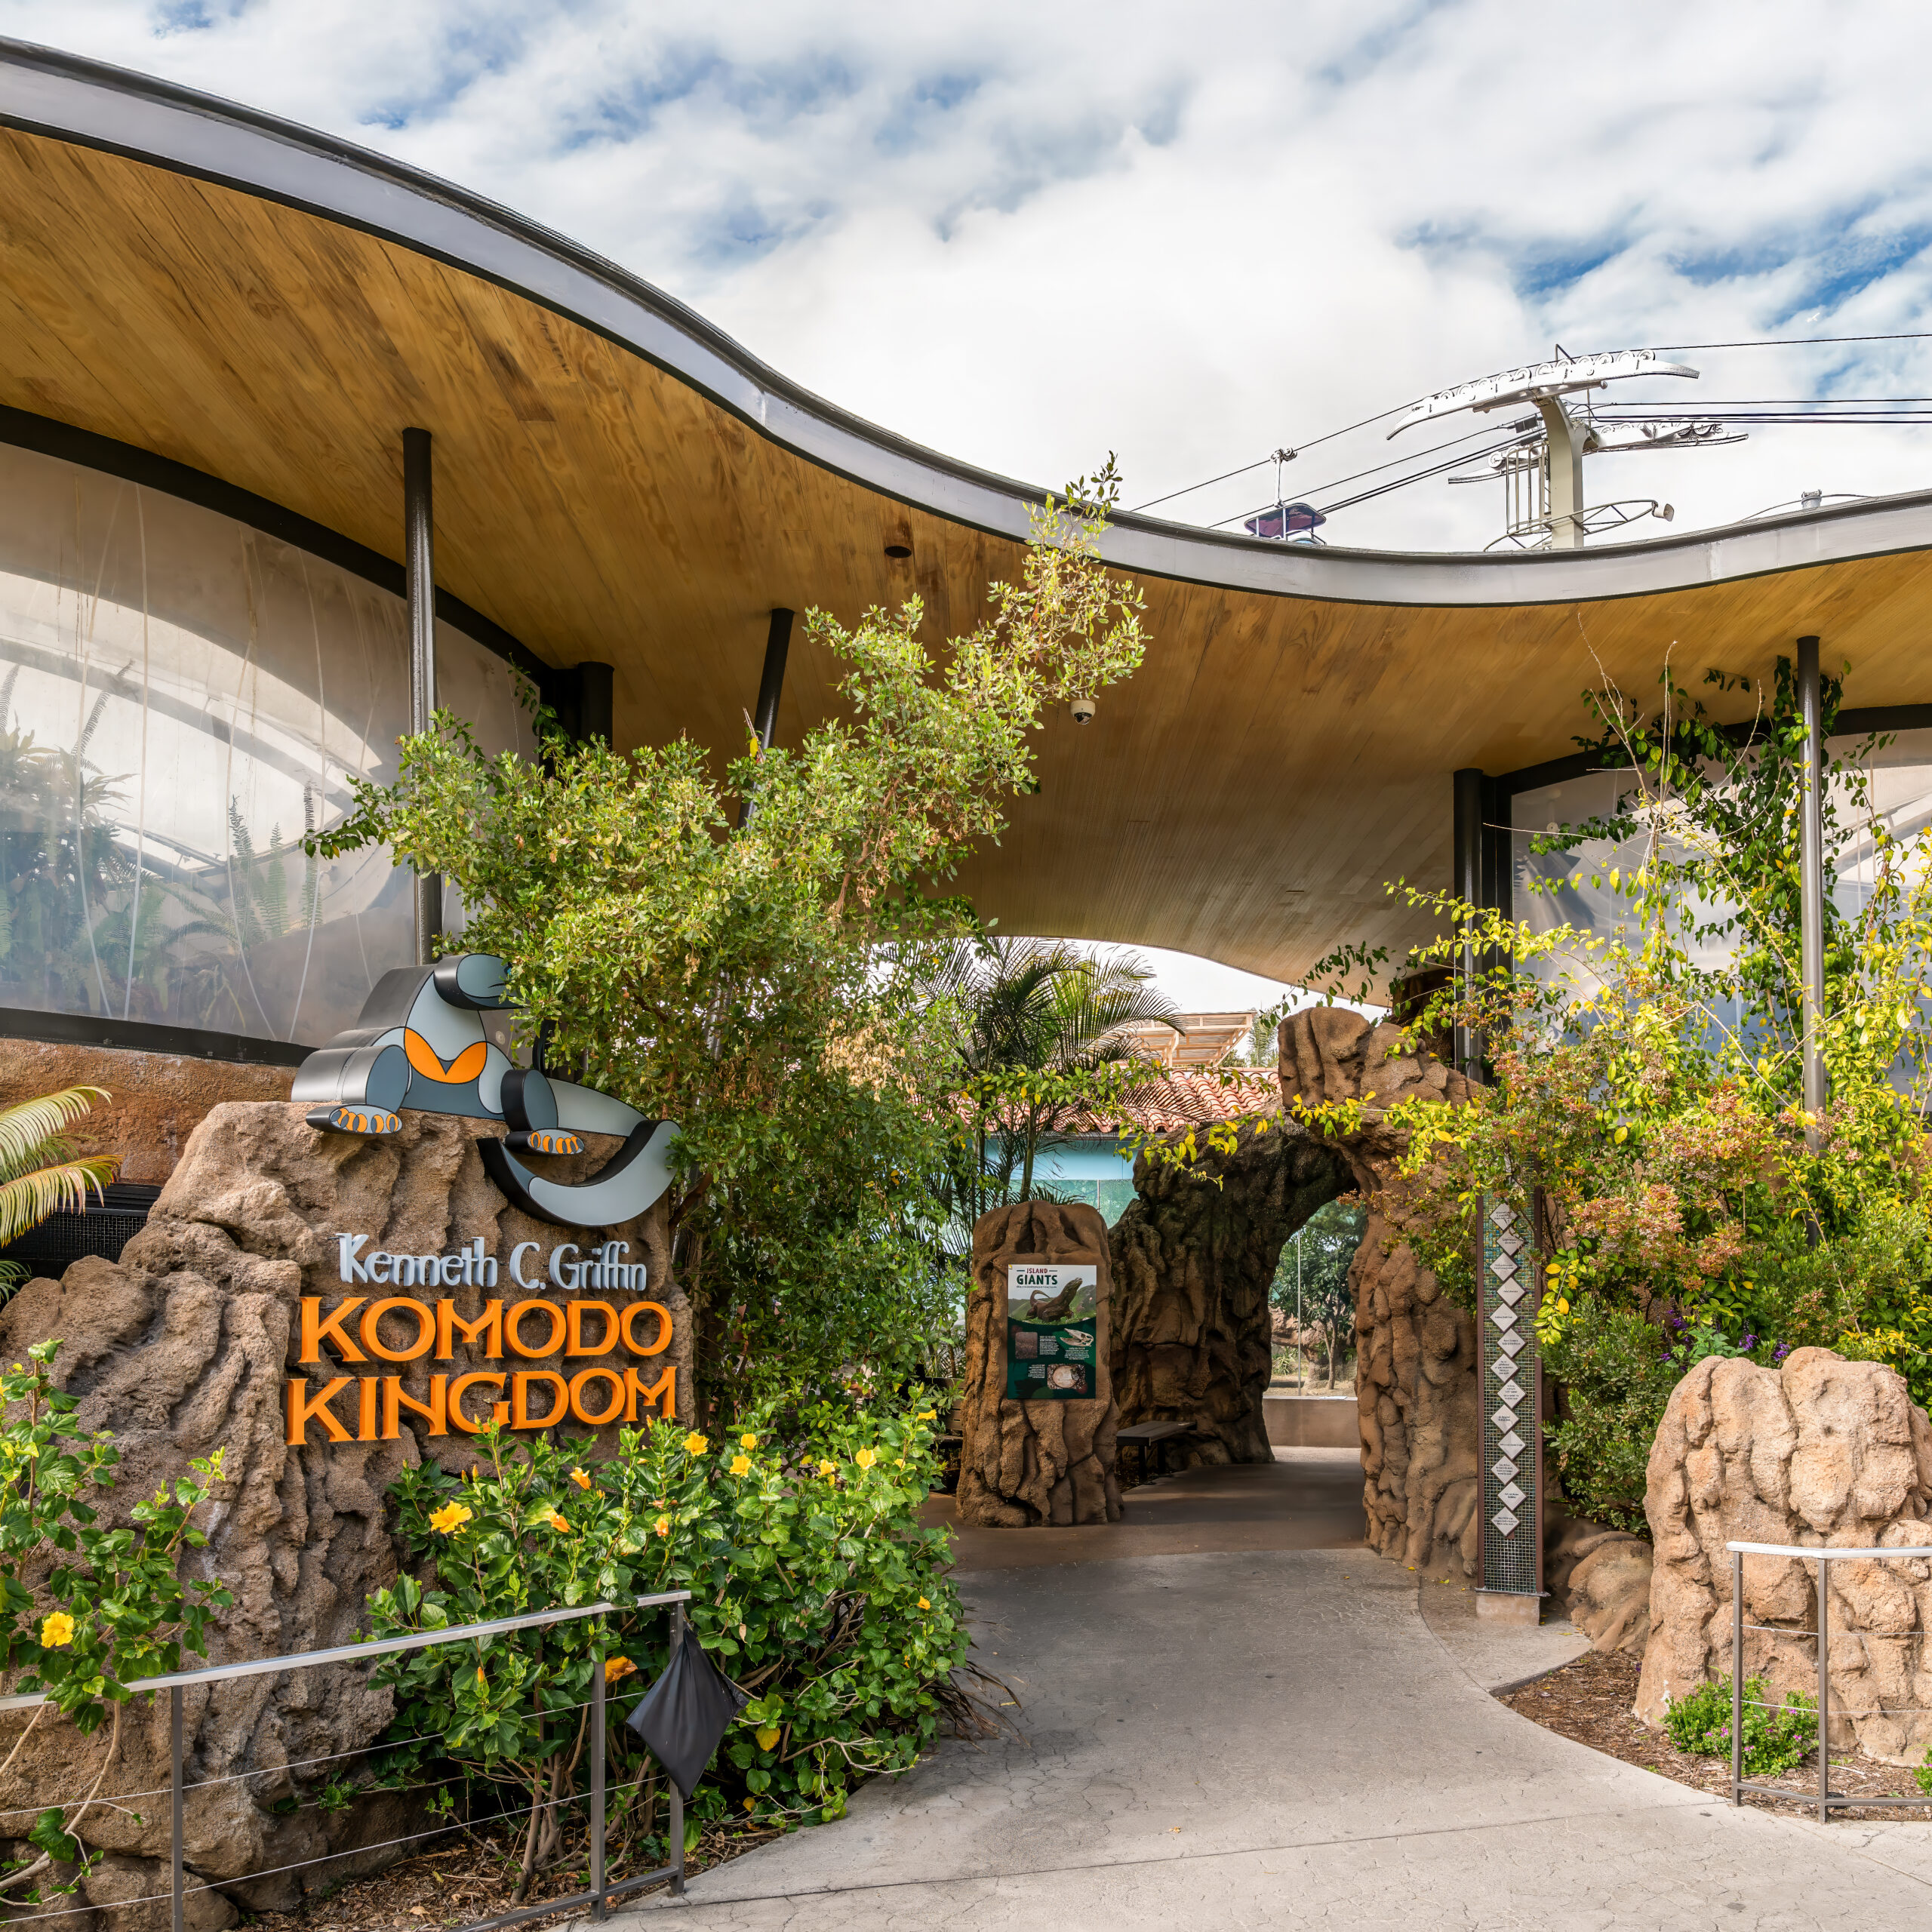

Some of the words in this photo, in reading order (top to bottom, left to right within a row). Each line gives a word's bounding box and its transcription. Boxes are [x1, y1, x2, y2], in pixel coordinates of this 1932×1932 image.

[336, 1232, 498, 1287] Kenneth
[509, 1241, 546, 1290] C.
[549, 1241, 647, 1291] Griffin
[1016, 1274, 1058, 1285] GIANTS
[298, 1297, 673, 1363] KOMODO
[285, 1366, 678, 1445] KINGDOM
